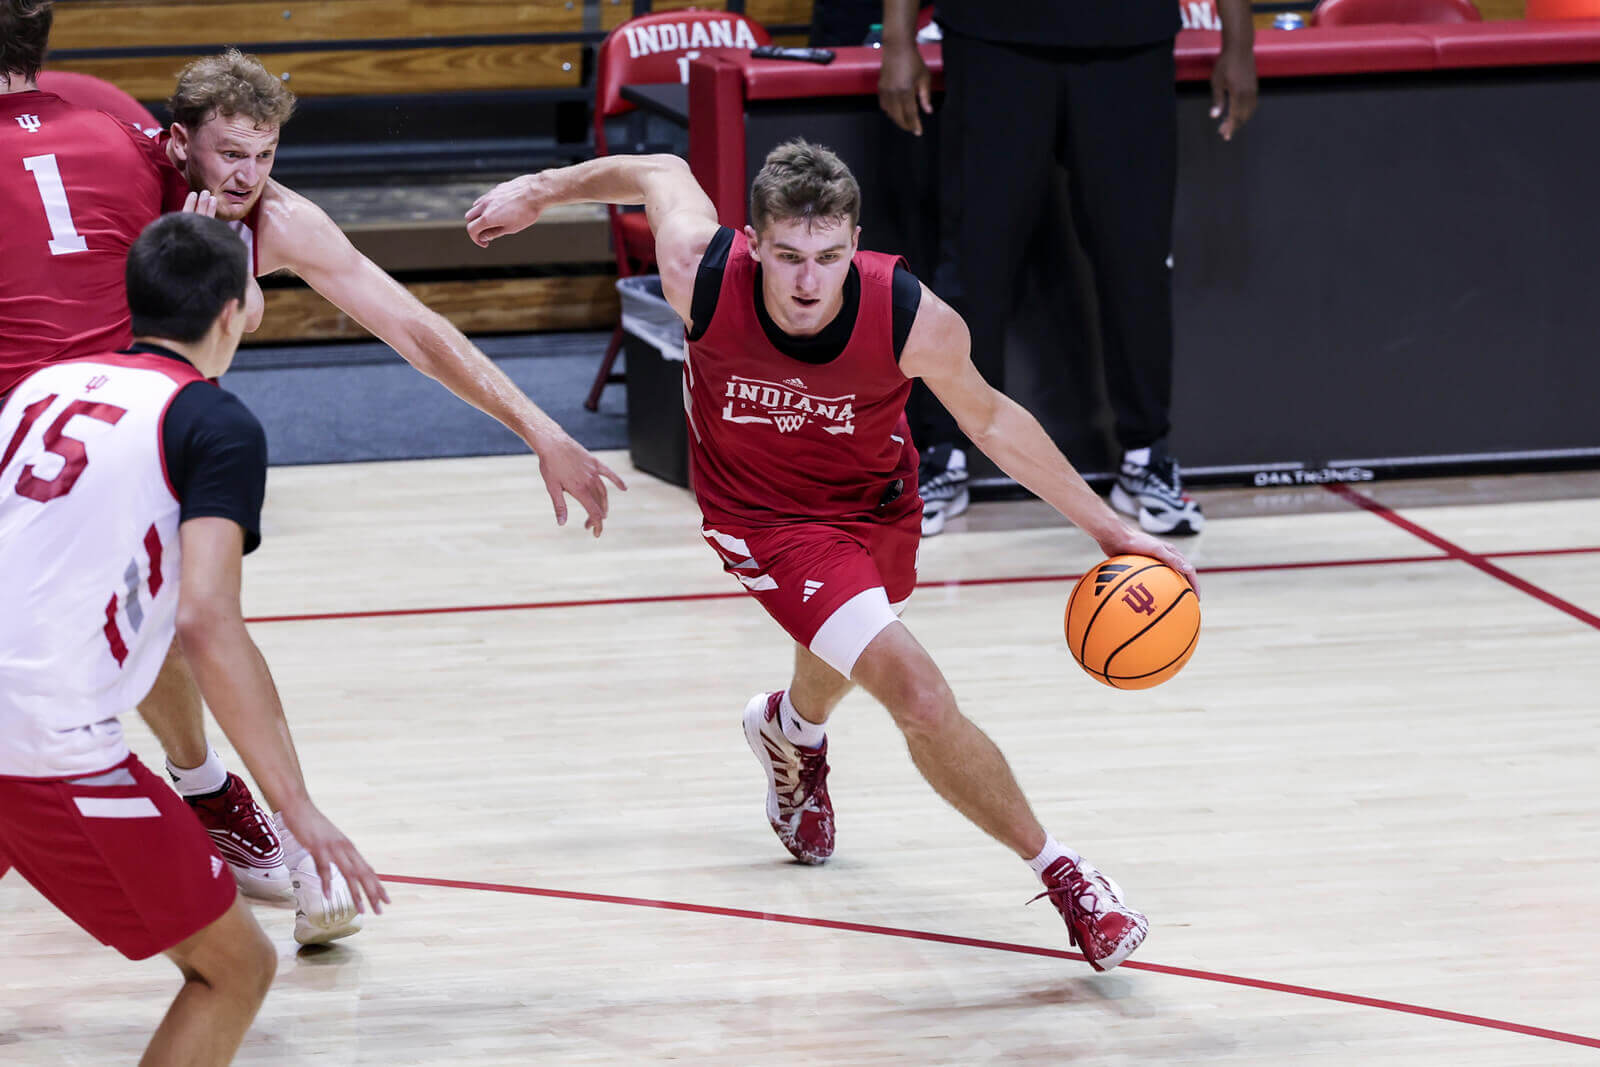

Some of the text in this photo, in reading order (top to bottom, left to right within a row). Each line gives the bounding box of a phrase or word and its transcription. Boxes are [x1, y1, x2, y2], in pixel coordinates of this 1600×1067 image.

[625, 20, 758, 58] INDIANA
[23, 153, 88, 255] 1
[724, 381, 855, 421] INDIANA
[0, 393, 128, 503] 15
